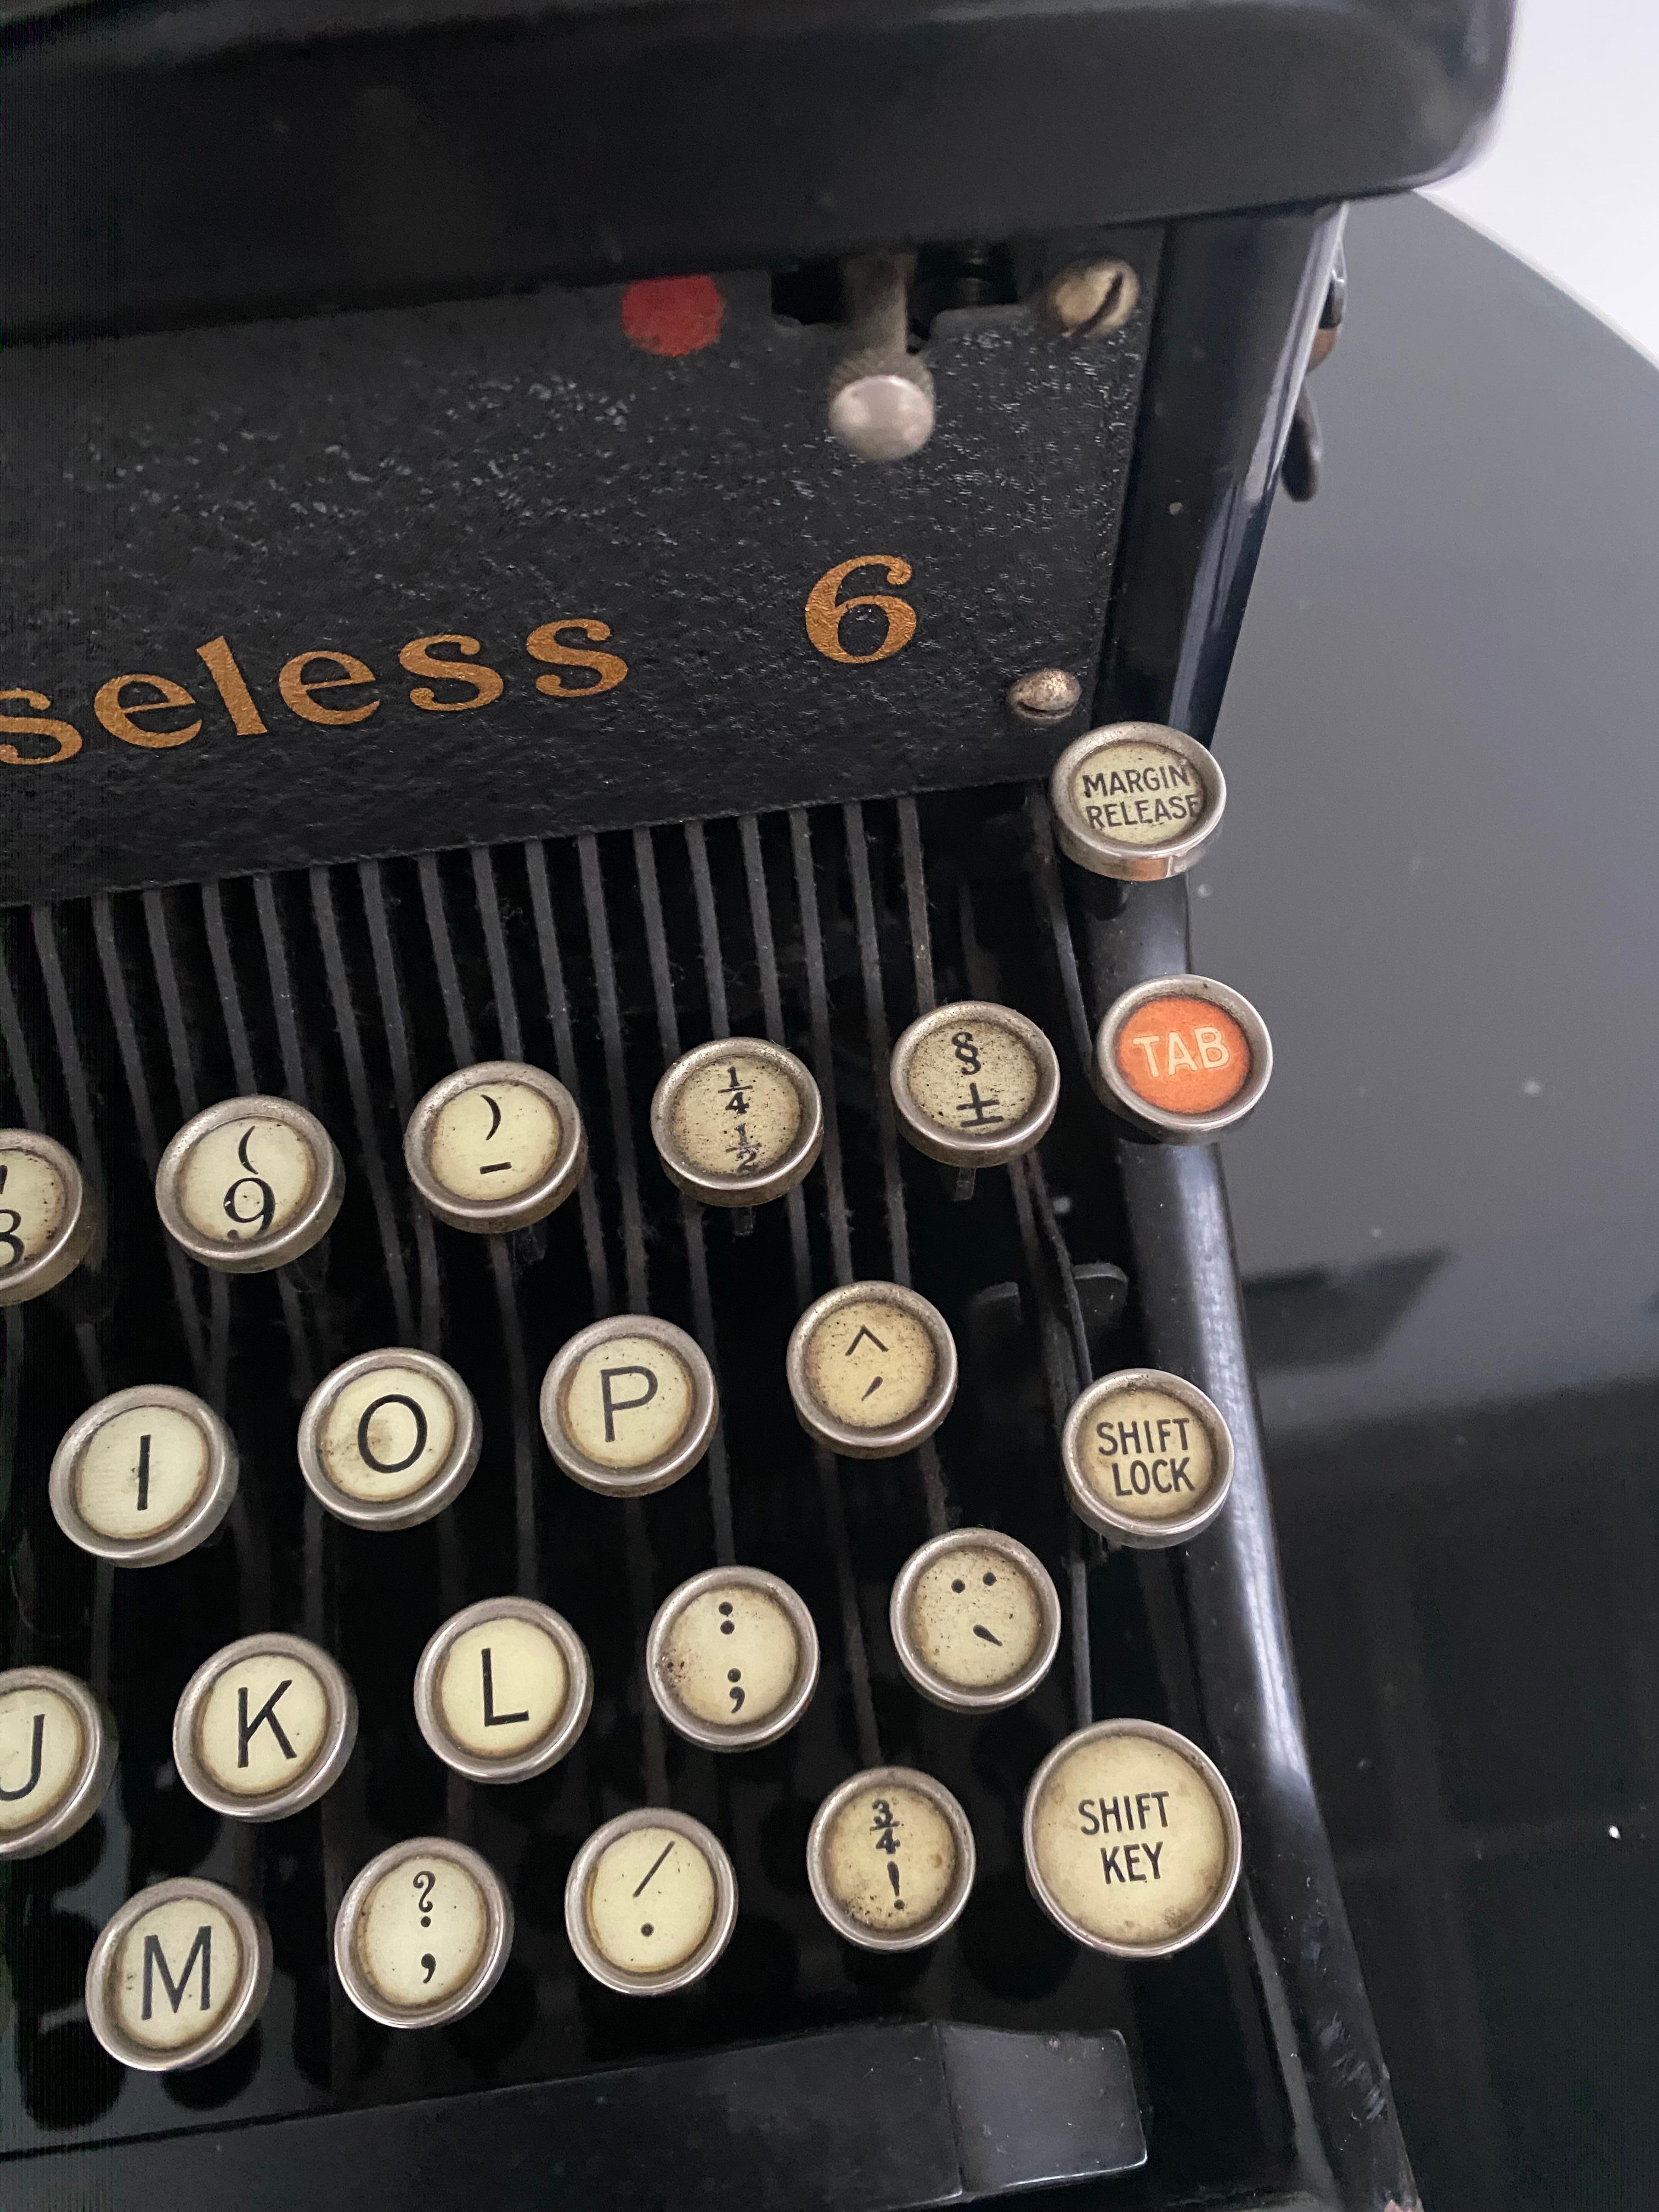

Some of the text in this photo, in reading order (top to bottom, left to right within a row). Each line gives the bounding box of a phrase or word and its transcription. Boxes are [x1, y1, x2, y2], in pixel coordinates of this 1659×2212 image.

[805, 555, 917, 663] 6
[1082, 764, 1189, 799] MARGIN
[1086, 793, 1200, 830] RELEASE
[1133, 1026, 1230, 1079] TAB
[223, 1177, 275, 1240] 9
[357, 1394, 428, 1474] O
[600, 1365, 658, 1443] P
[1097, 1418, 1190, 1456] SHIFT
[137, 1434, 151, 1511] I
[1111, 1457, 1195, 1497] LOCK
[481, 1647, 529, 1728] L
[238, 1679, 298, 1769] K
[1078, 1791, 1170, 1835] SHIFT
[1100, 1841, 1164, 1884] KEY
[140, 1925, 212, 2021] M
